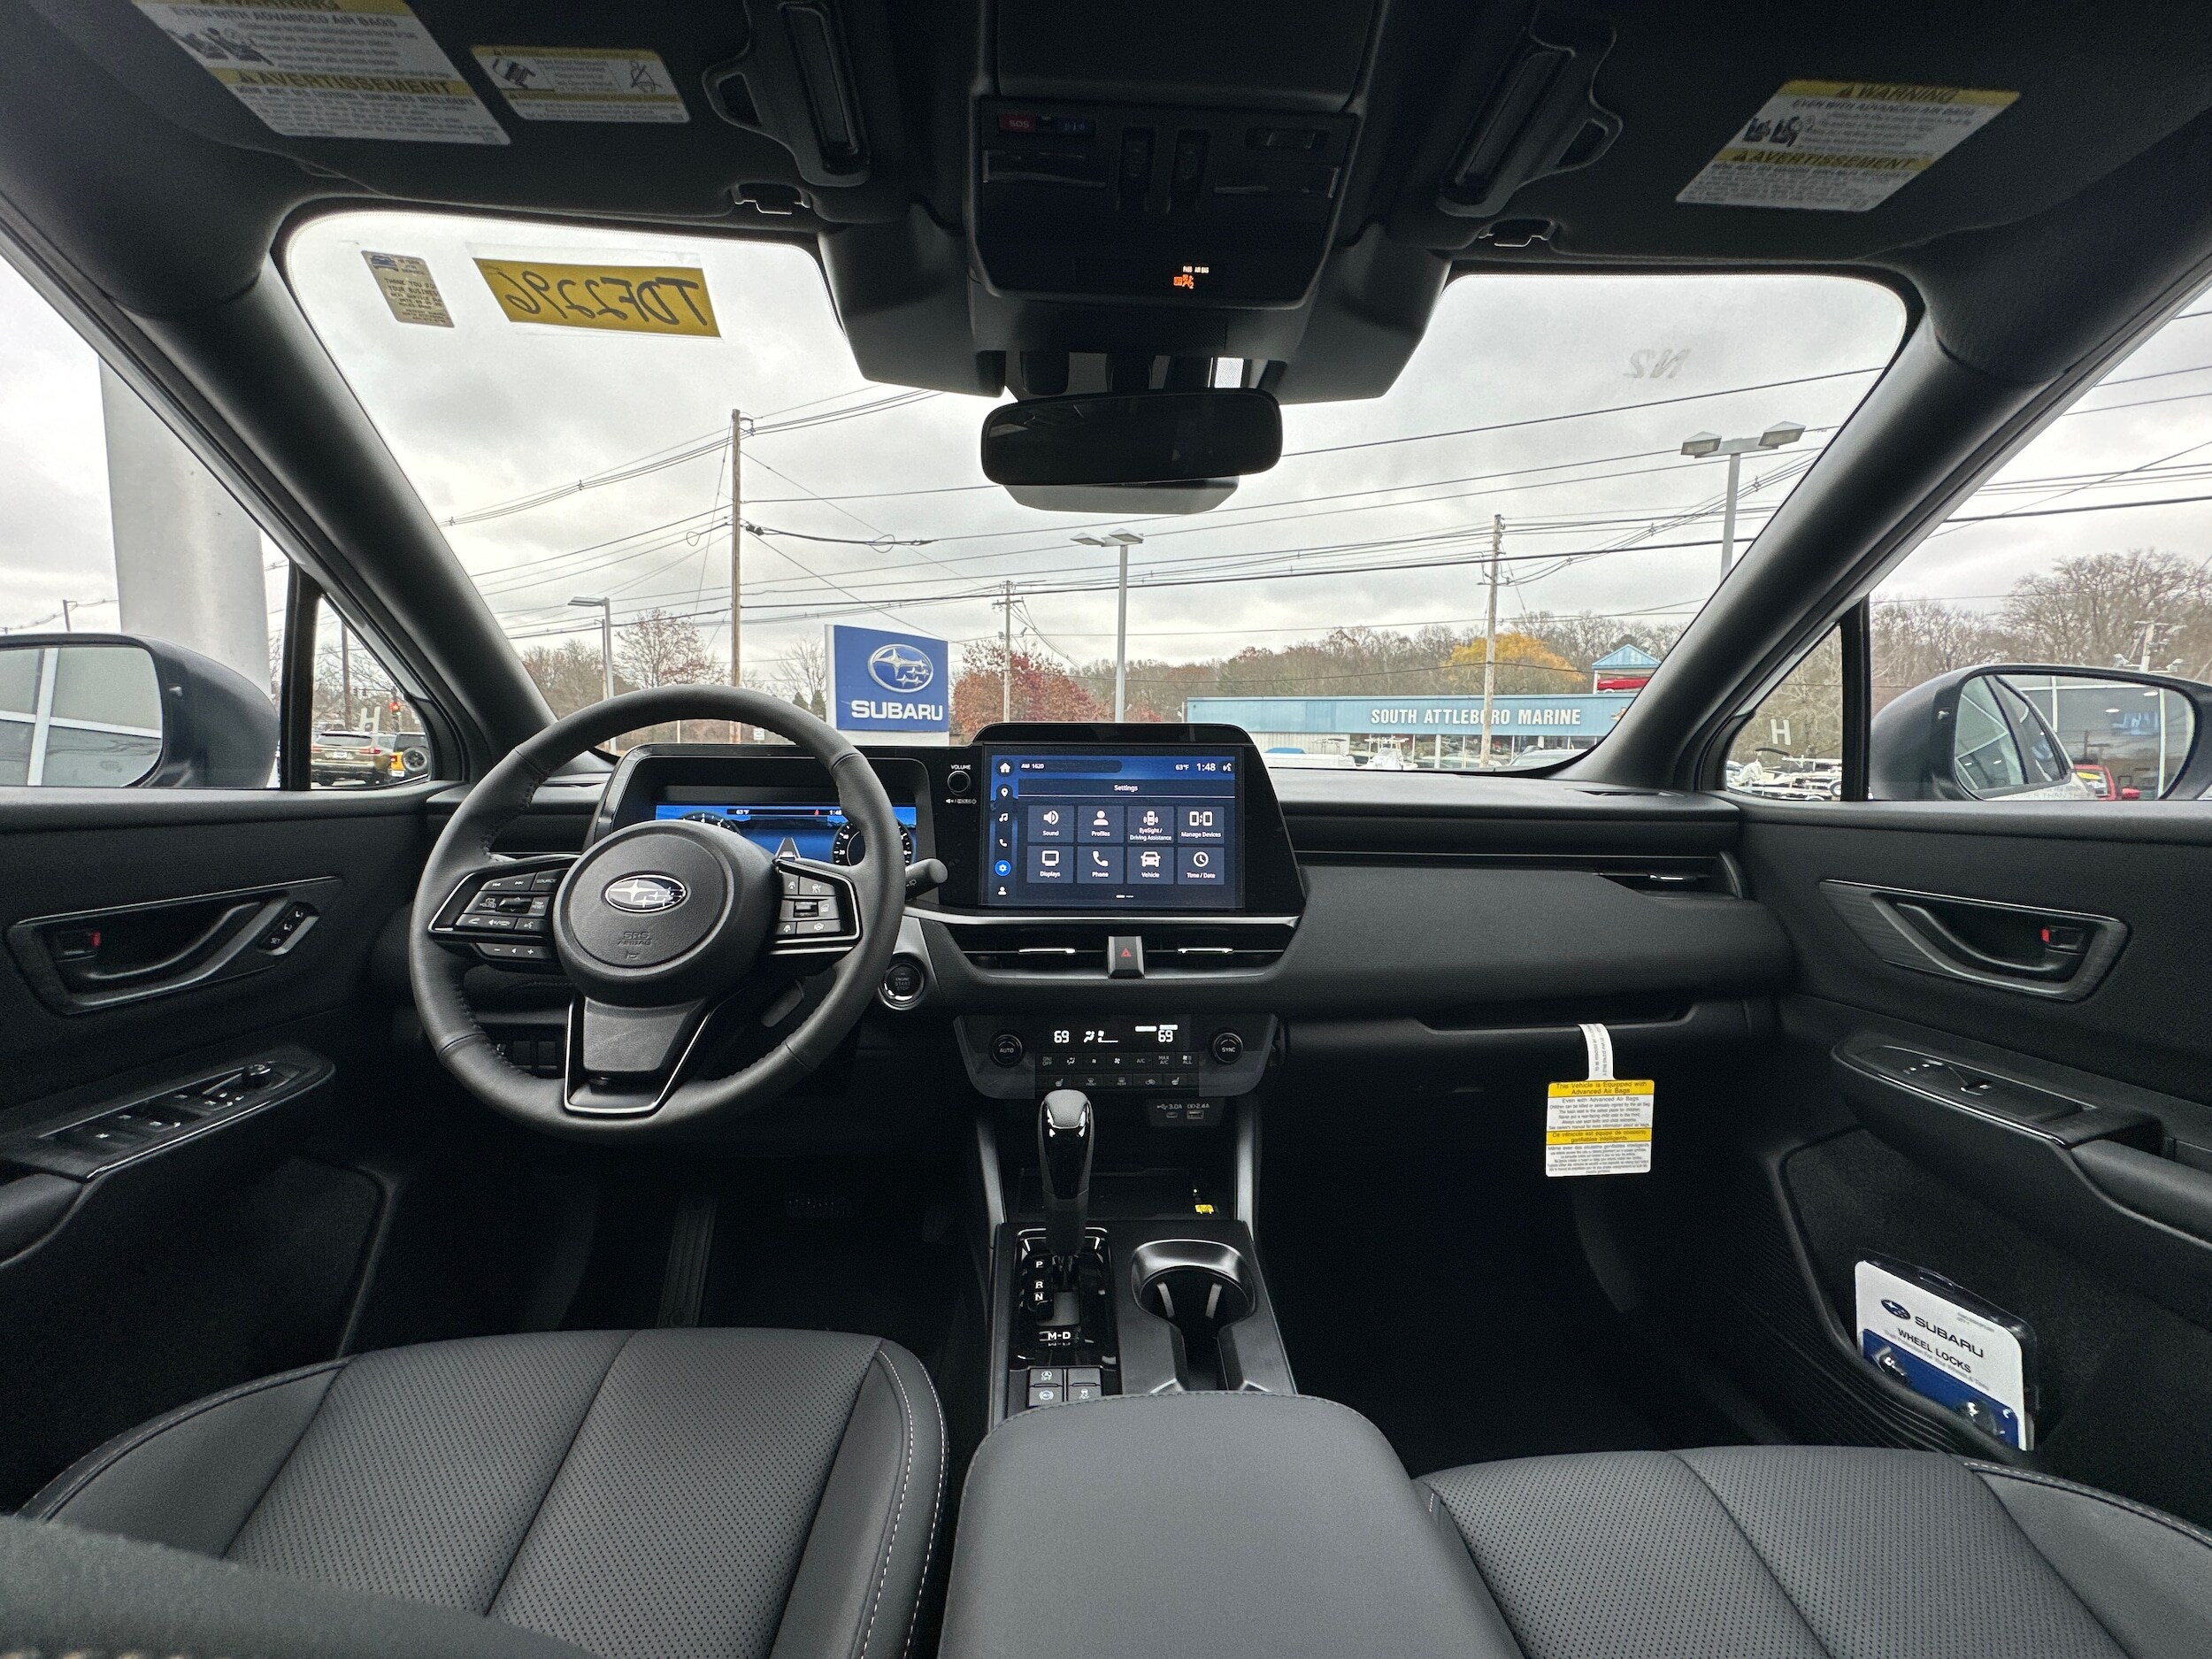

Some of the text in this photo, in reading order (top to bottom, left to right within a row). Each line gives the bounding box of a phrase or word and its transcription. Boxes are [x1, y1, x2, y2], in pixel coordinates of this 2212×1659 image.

[257, 72, 452, 96] AVERTISSEMENT
[1856, 84, 1956, 104] WARNING
[1009, 119, 1029, 128] SOS
[1748, 150, 1913, 167] AVERTISSEMENT
[851, 700, 943, 721] SUBARU
[1371, 709, 1417, 725] SOUTH
[1517, 709, 1581, 725] MARINE
[1196, 763, 1217, 772] 1:48
[1114, 784, 1139, 793] Settings
[623, 931, 649, 940] SRS
[1054, 1030, 1070, 1043] 69
[1157, 1030, 1173, 1042] 69
[1915, 1316, 1984, 1357] SUBARU
[1898, 1327, 1971, 1373] WHEEL LOCKS
